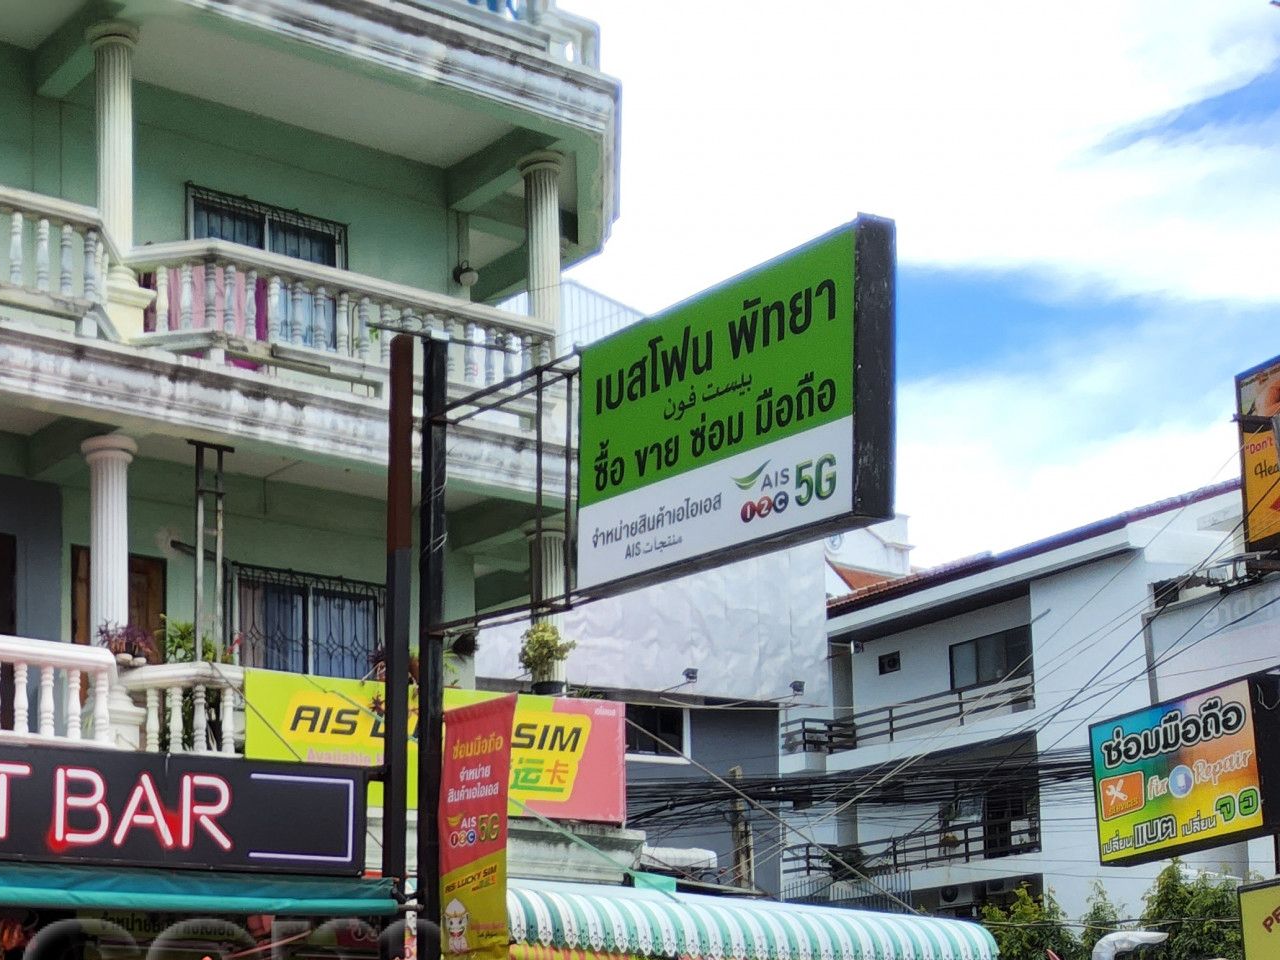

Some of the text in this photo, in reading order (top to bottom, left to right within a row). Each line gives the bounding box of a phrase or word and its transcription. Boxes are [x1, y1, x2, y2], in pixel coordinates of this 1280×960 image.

[596, 279, 837, 415] เบสโฟน พัทยา
[594, 371, 837, 492] ซื้อ ขาย ซ่อม มือถือ
[761, 453, 836, 507] AIS 5G
[625, 542, 641, 560] AIS
[290, 705, 360, 735] AIS
[511, 723, 582, 753] SIM
[1102, 696, 1246, 769] ซ่อมมือถือ
[55, 766, 232, 851] BAR
[461, 813, 500, 842] AIS 5G
[1134, 814, 1177, 849] แบต
[1216, 786, 1259, 822] จอ
[457, 871, 482, 889] LUCKY
[483, 864, 498, 878] SIM
